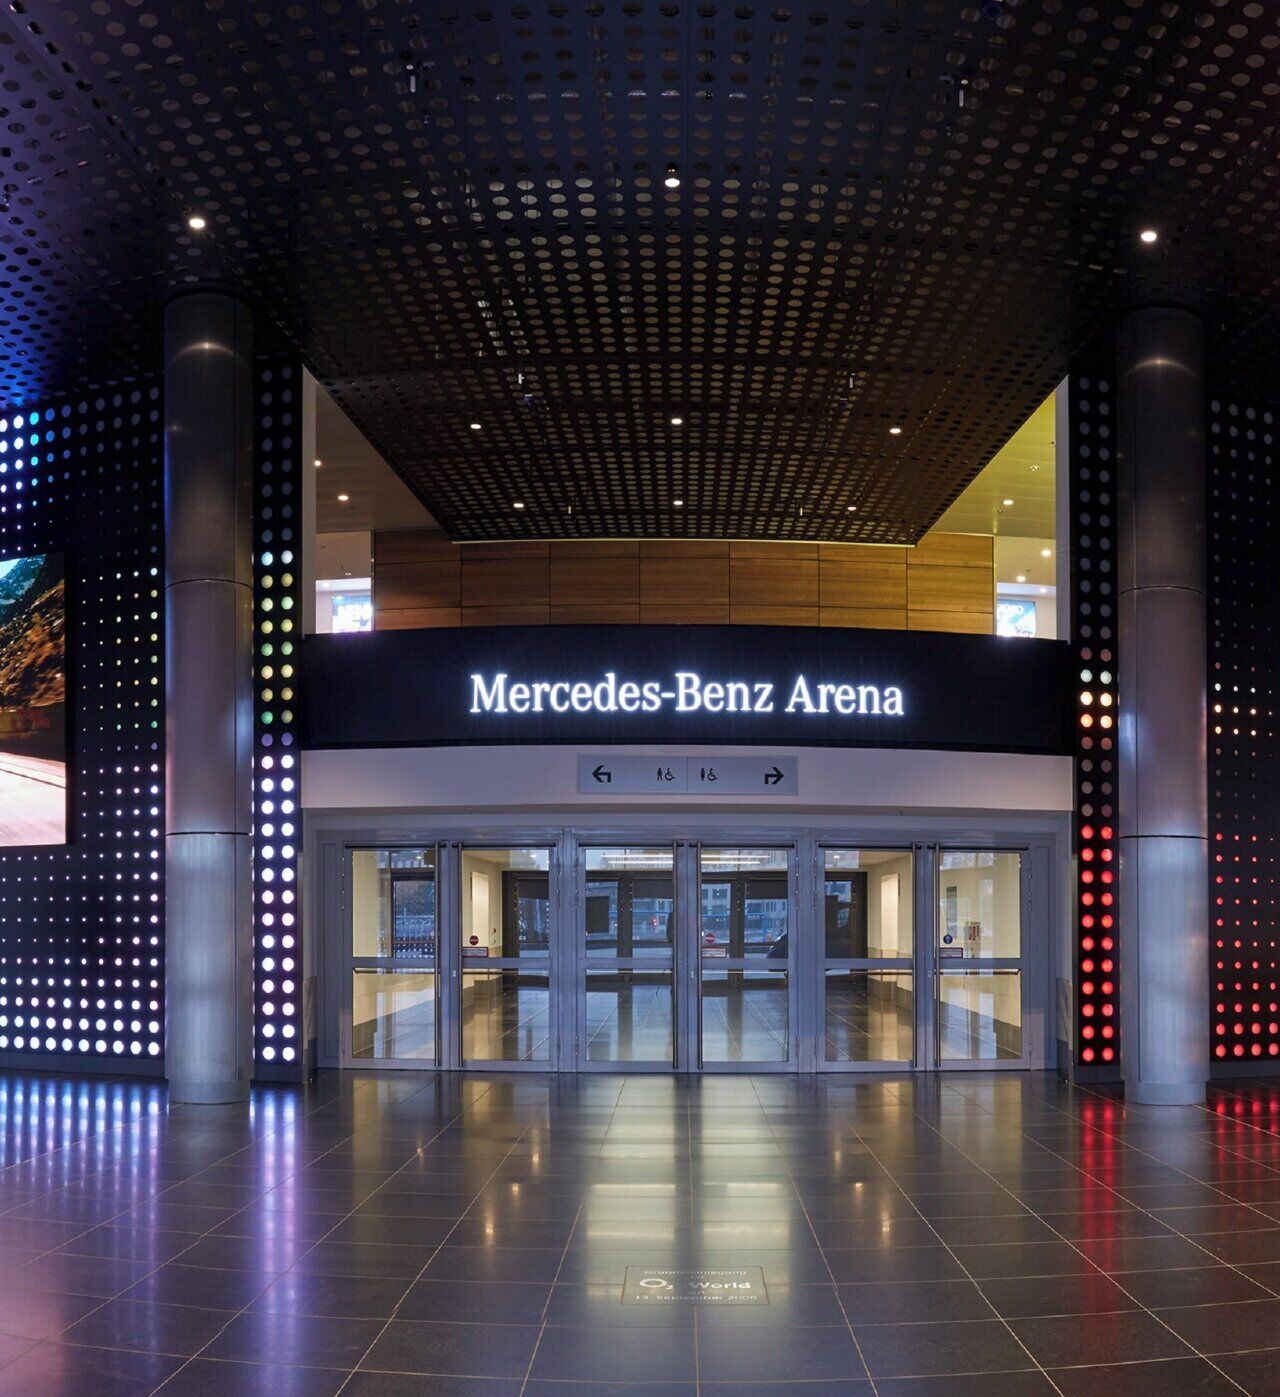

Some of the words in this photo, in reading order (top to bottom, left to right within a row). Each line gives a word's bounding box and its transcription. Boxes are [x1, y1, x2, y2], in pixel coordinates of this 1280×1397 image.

[469, 672, 774, 713] Mercedes-Benz
[785, 674, 905, 715] Arena
[689, 1281, 752, 1290] World
